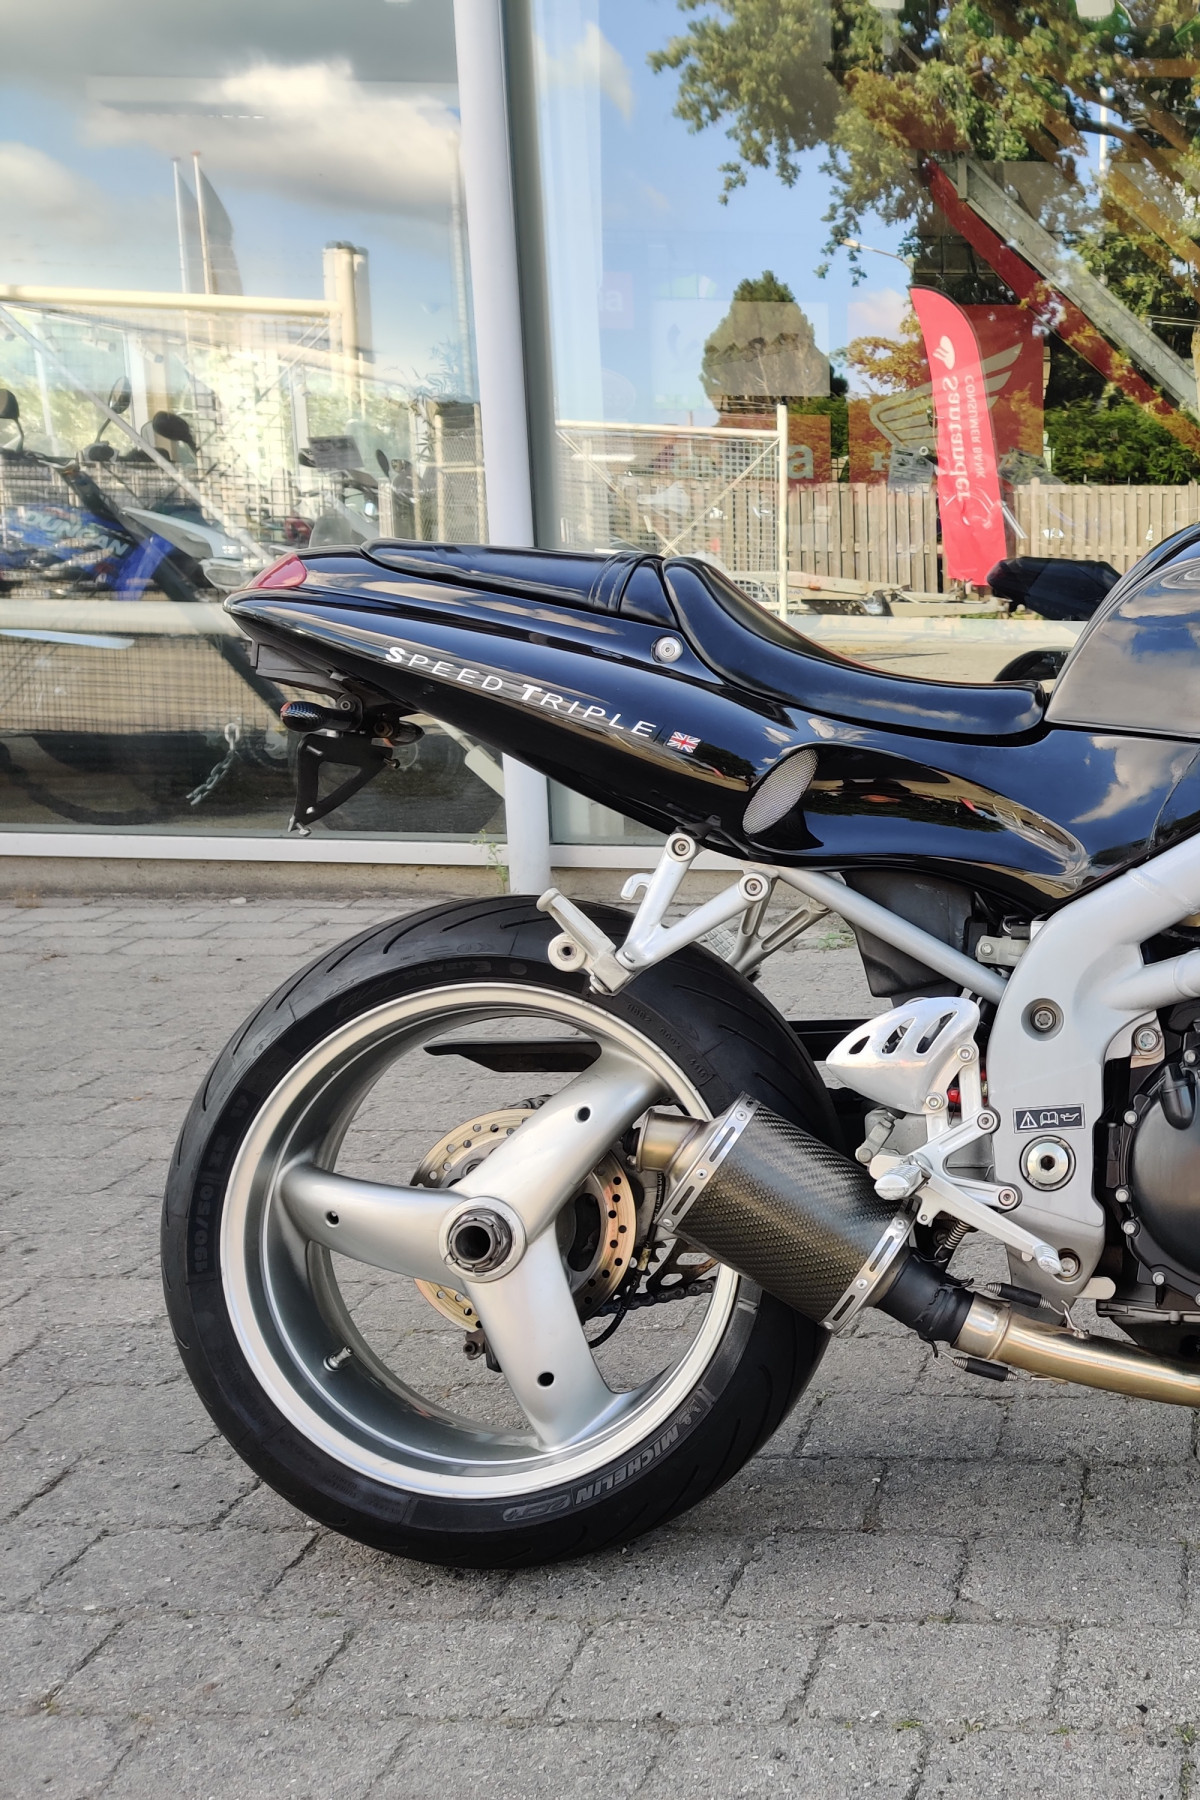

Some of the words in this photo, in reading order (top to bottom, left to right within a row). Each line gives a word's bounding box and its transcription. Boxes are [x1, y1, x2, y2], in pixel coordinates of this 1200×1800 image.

[385, 645, 503, 692] SPEED
[520, 682, 657, 738] TRIPLE
[574, 1421, 680, 1505] MICHELIN
